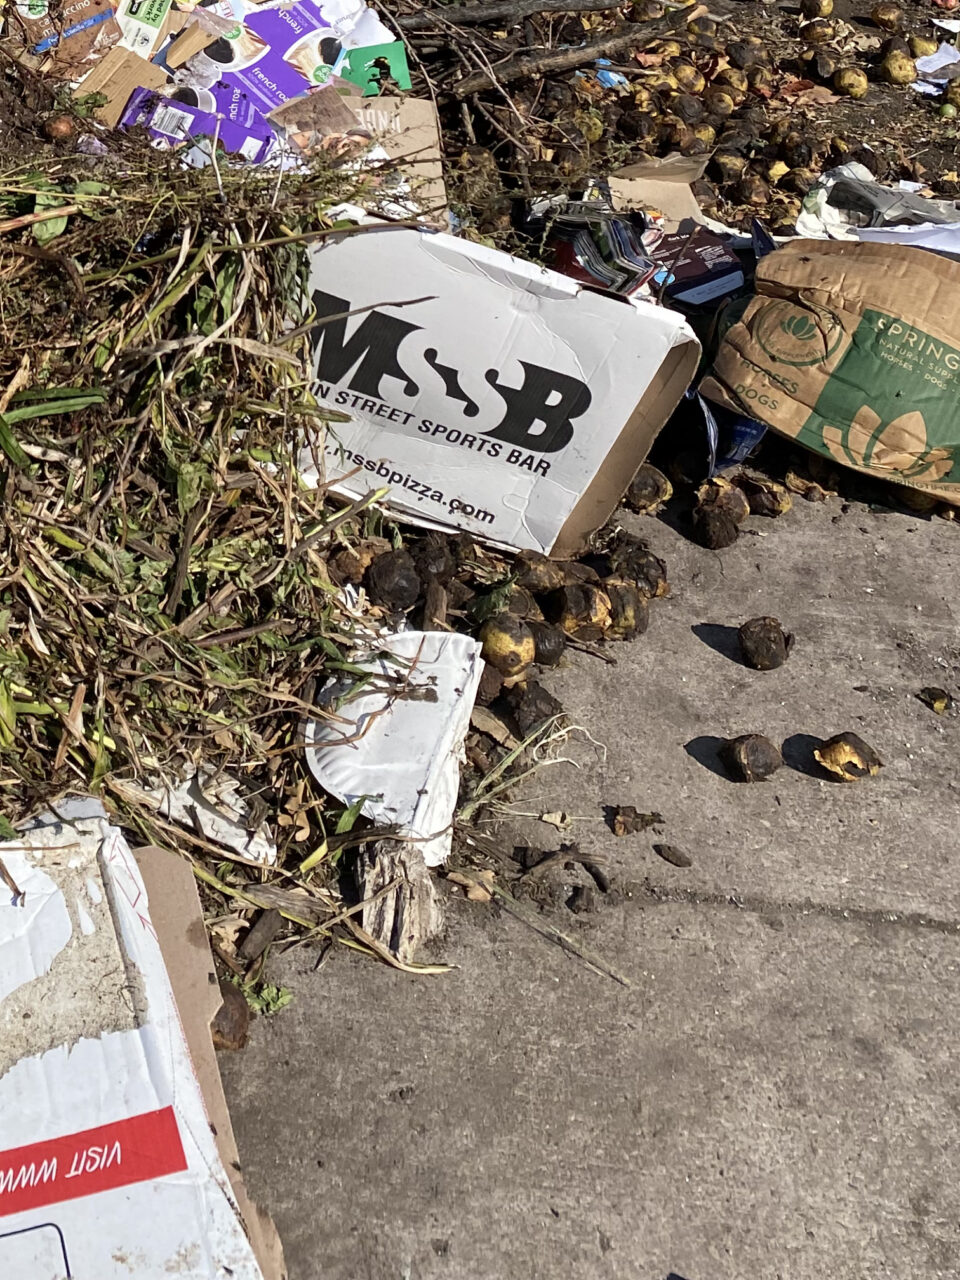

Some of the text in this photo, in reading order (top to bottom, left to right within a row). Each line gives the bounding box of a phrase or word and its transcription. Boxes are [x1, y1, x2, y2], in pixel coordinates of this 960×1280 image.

[277, 9, 304, 36] french
[251, 67, 278, 93] french
[873, 318, 960, 370] SPRING
[879, 338, 960, 385] NATURAL SUPPL
[302, 288, 593, 454] MSSB
[880, 351, 948, 391] HORSES DOGS
[734, 383, 779, 410] DOGS
[334, 390, 417, 426] STREET
[417, 419, 504, 458] SPORTS
[504, 449, 552, 478] BAR
[64, 1140, 123, 1179] VISIT
